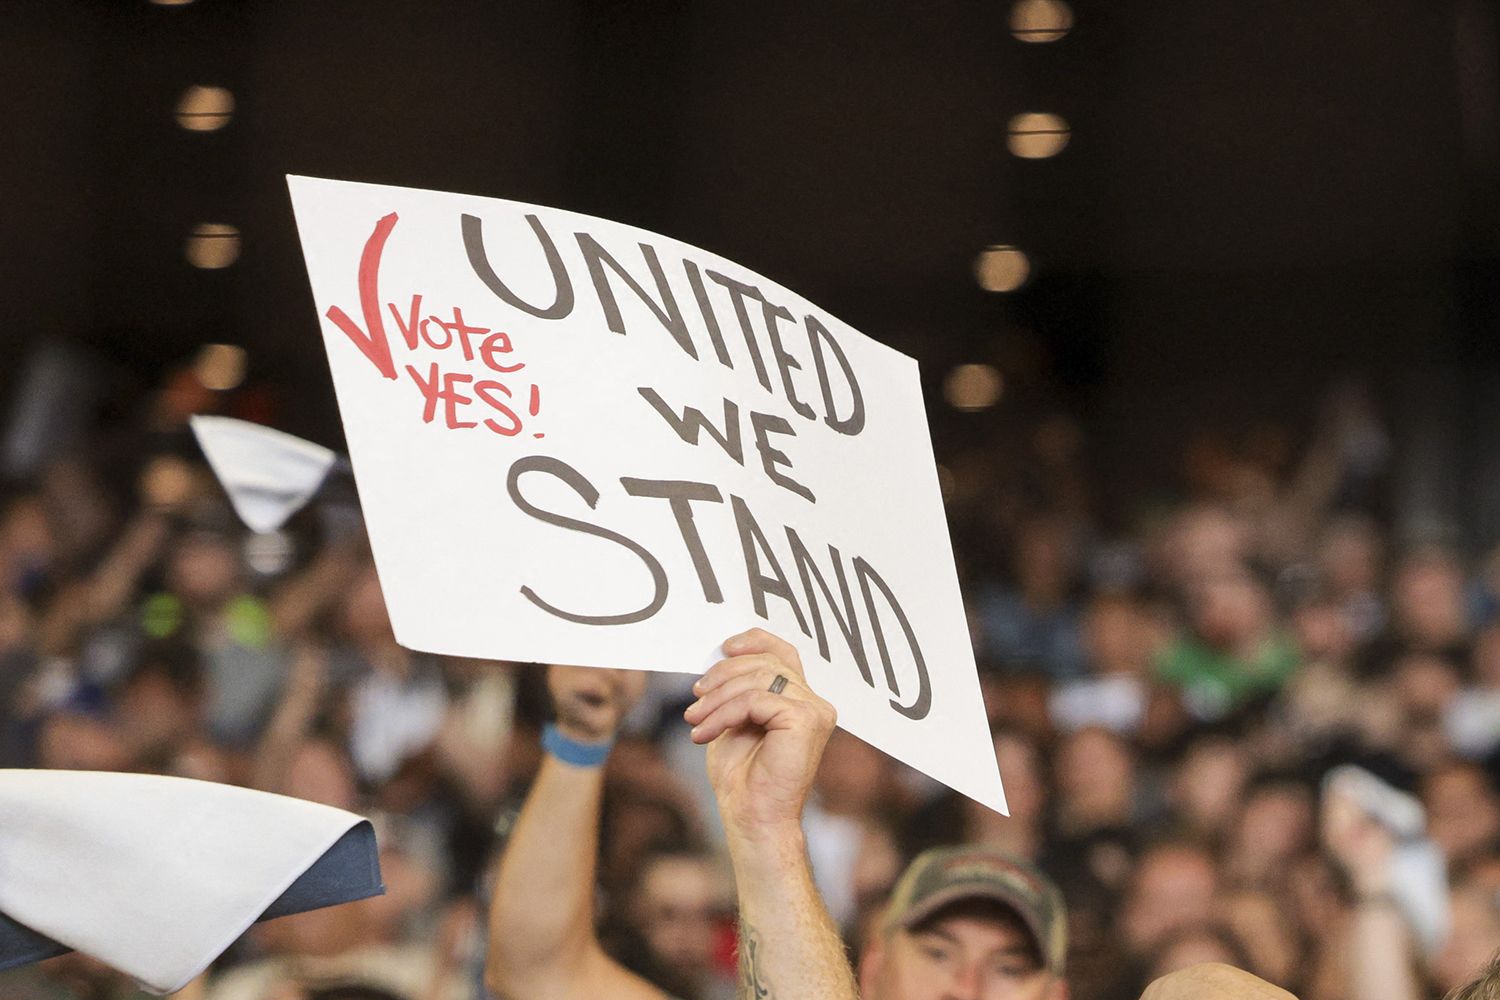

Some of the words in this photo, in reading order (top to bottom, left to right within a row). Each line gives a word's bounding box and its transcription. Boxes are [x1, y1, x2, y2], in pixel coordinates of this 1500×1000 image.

[388, 293, 526, 374] Vote
[461, 213, 867, 436] UNITED
[405, 362, 546, 439] YES!
[637, 386, 817, 505] WE
[506, 455, 933, 721] STAND
